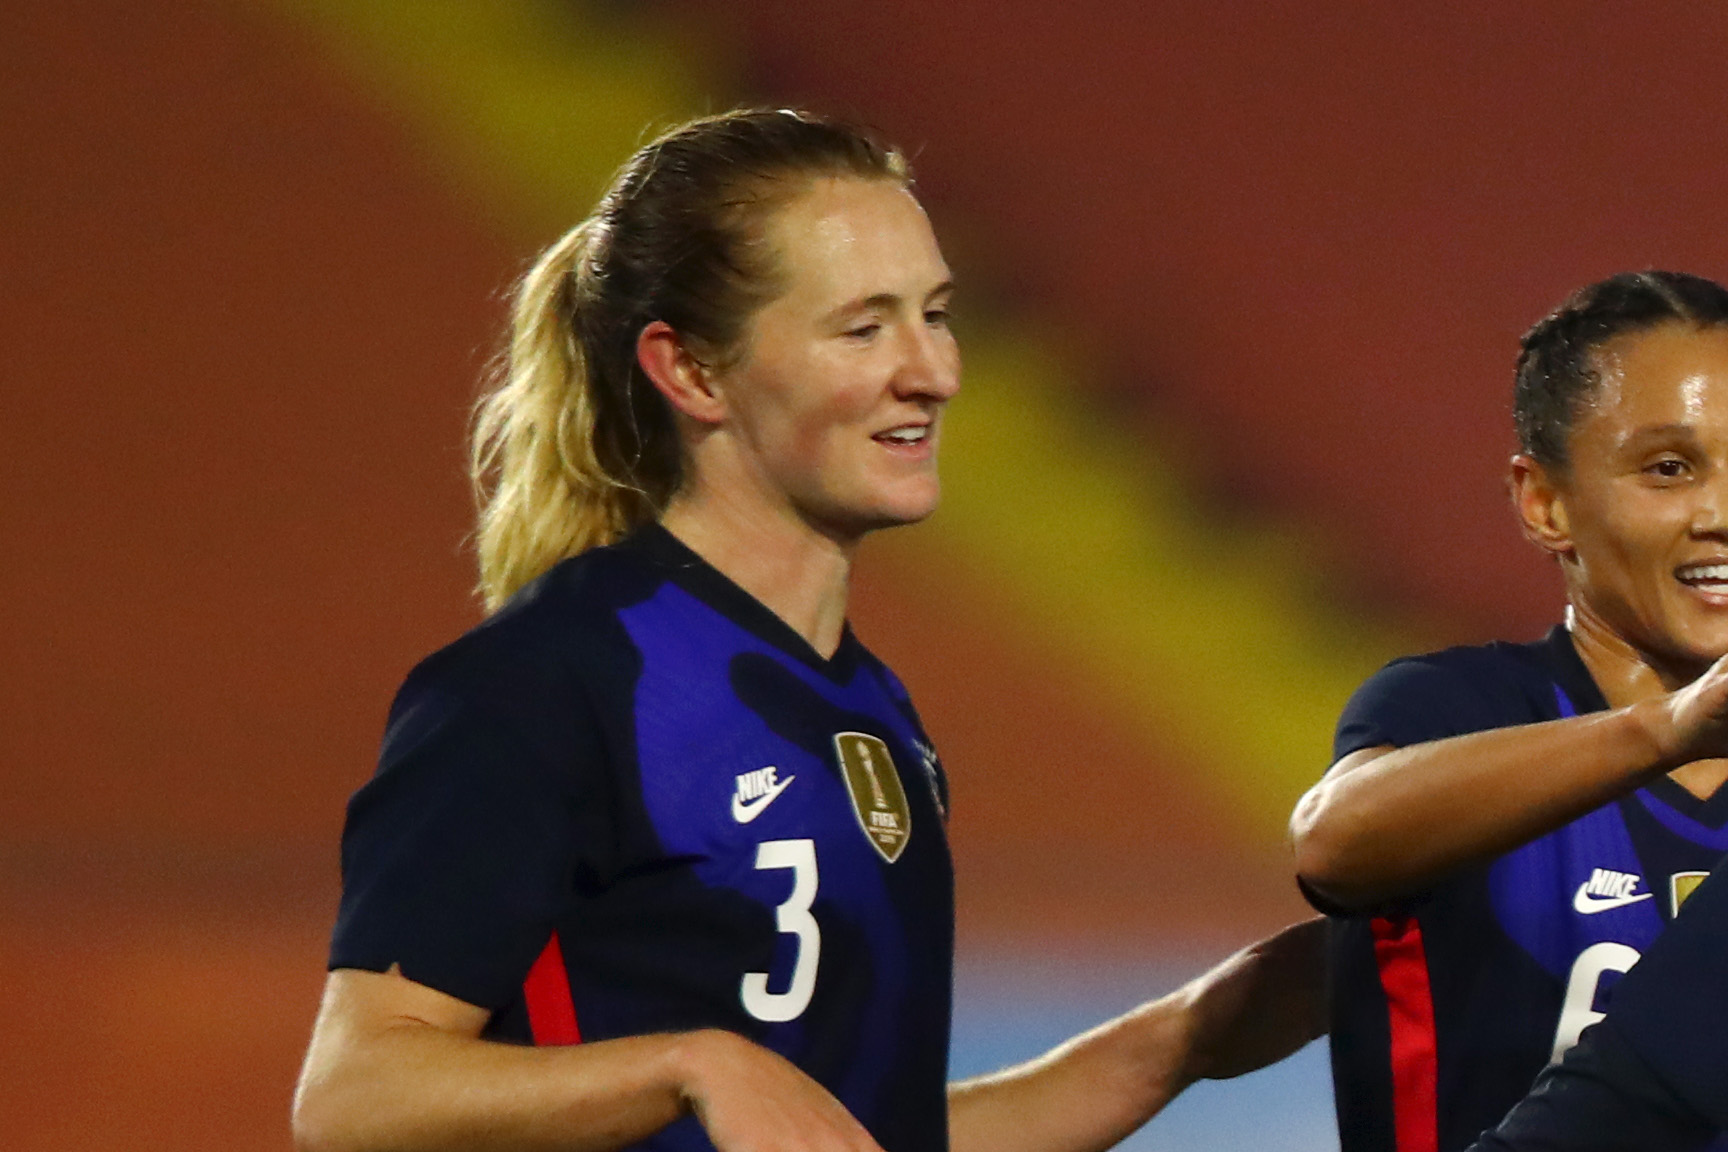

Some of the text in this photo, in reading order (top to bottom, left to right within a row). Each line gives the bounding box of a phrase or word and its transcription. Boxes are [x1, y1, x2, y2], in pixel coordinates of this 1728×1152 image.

[735, 765, 778, 801] NIKE
[870, 811, 898, 828] FIFA
[1586, 867, 1640, 899] NIKE
[740, 838, 821, 1023] 3
